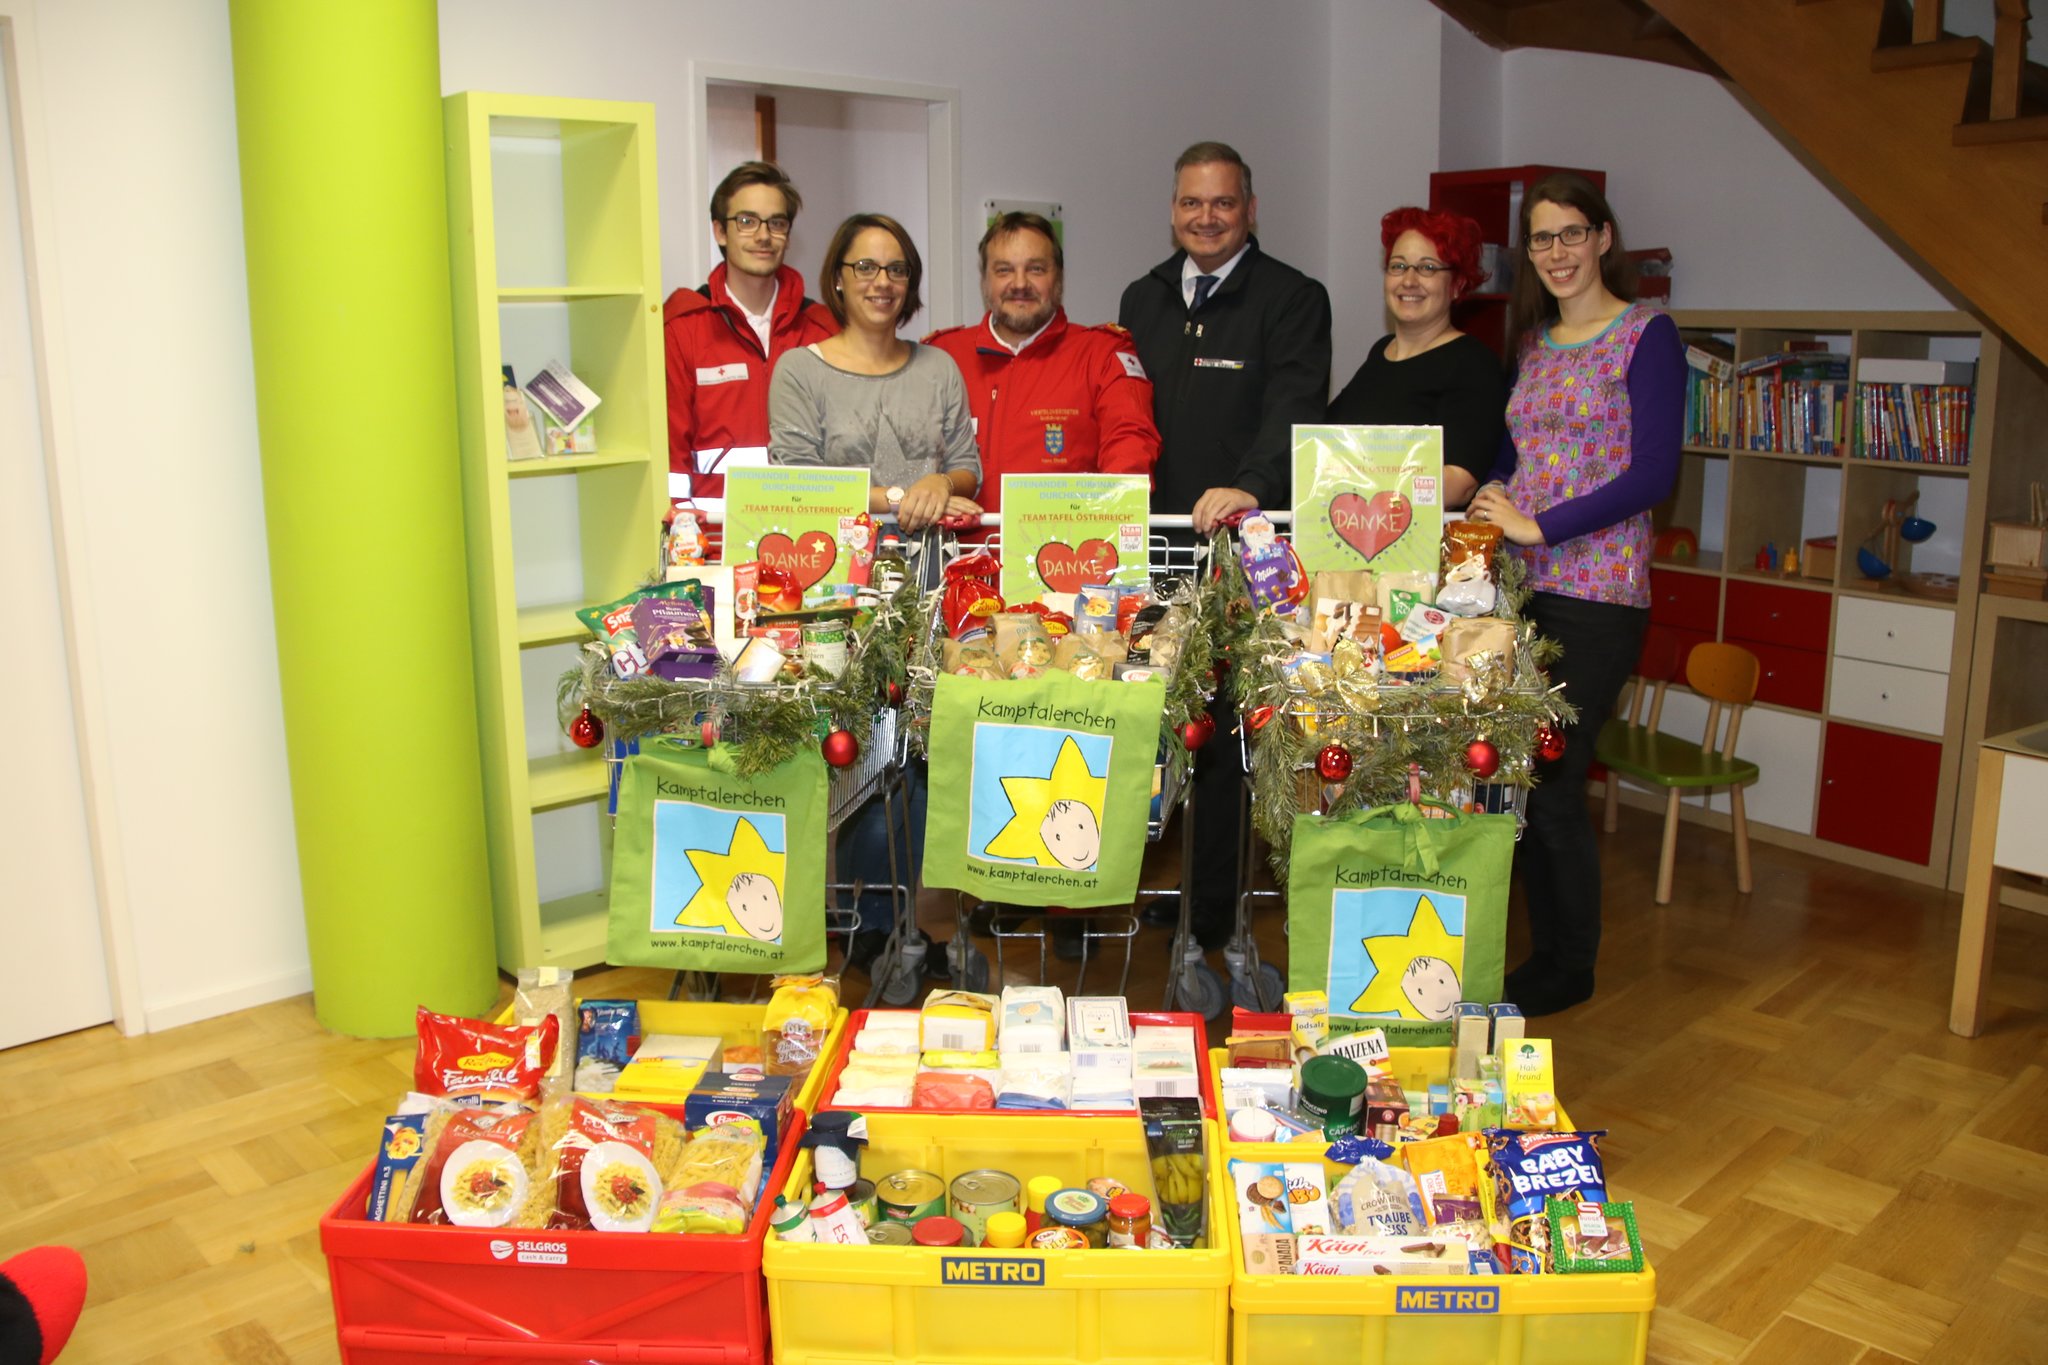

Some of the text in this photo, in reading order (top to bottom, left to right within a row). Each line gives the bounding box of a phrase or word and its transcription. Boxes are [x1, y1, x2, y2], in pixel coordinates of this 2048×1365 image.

[770, 505, 795, 513] TAFEL
[1070, 503, 1081, 511] für
[1049, 513, 1074, 521] TAFEL
[1334, 509, 1405, 532] DANKE
[763, 551, 822, 569] DANKE
[1043, 560, 1105, 577] DANKE
[1254, 566, 1279, 583] Milka
[976, 696, 1116, 729] Kamptalerchen
[656, 775, 786, 808] Kamptalerchen
[966, 862, 1099, 889] www.kamptalerchen.at
[650, 936, 785, 961] www.kamptalerchen.at
[1296, 1021, 1325, 1032] Jodsalz
[1333, 1038, 1384, 1060] MAIZENA
[443, 1068, 520, 1089] Familie
[1516, 1072, 1542, 1083] freund
[1520, 1146, 1585, 1174] BABY
[1512, 1165, 1604, 1193] BREZEL
[1367, 1211, 1412, 1227] TRAUBE
[832, 1223, 851, 1244] ES
[516, 1240, 568, 1253] SELGROS
[1306, 1239, 1369, 1255] Kägi
[945, 1261, 1041, 1282] METRO
[1303, 1262, 1341, 1276] Kägi
[1400, 1290, 1495, 1310] METRO
